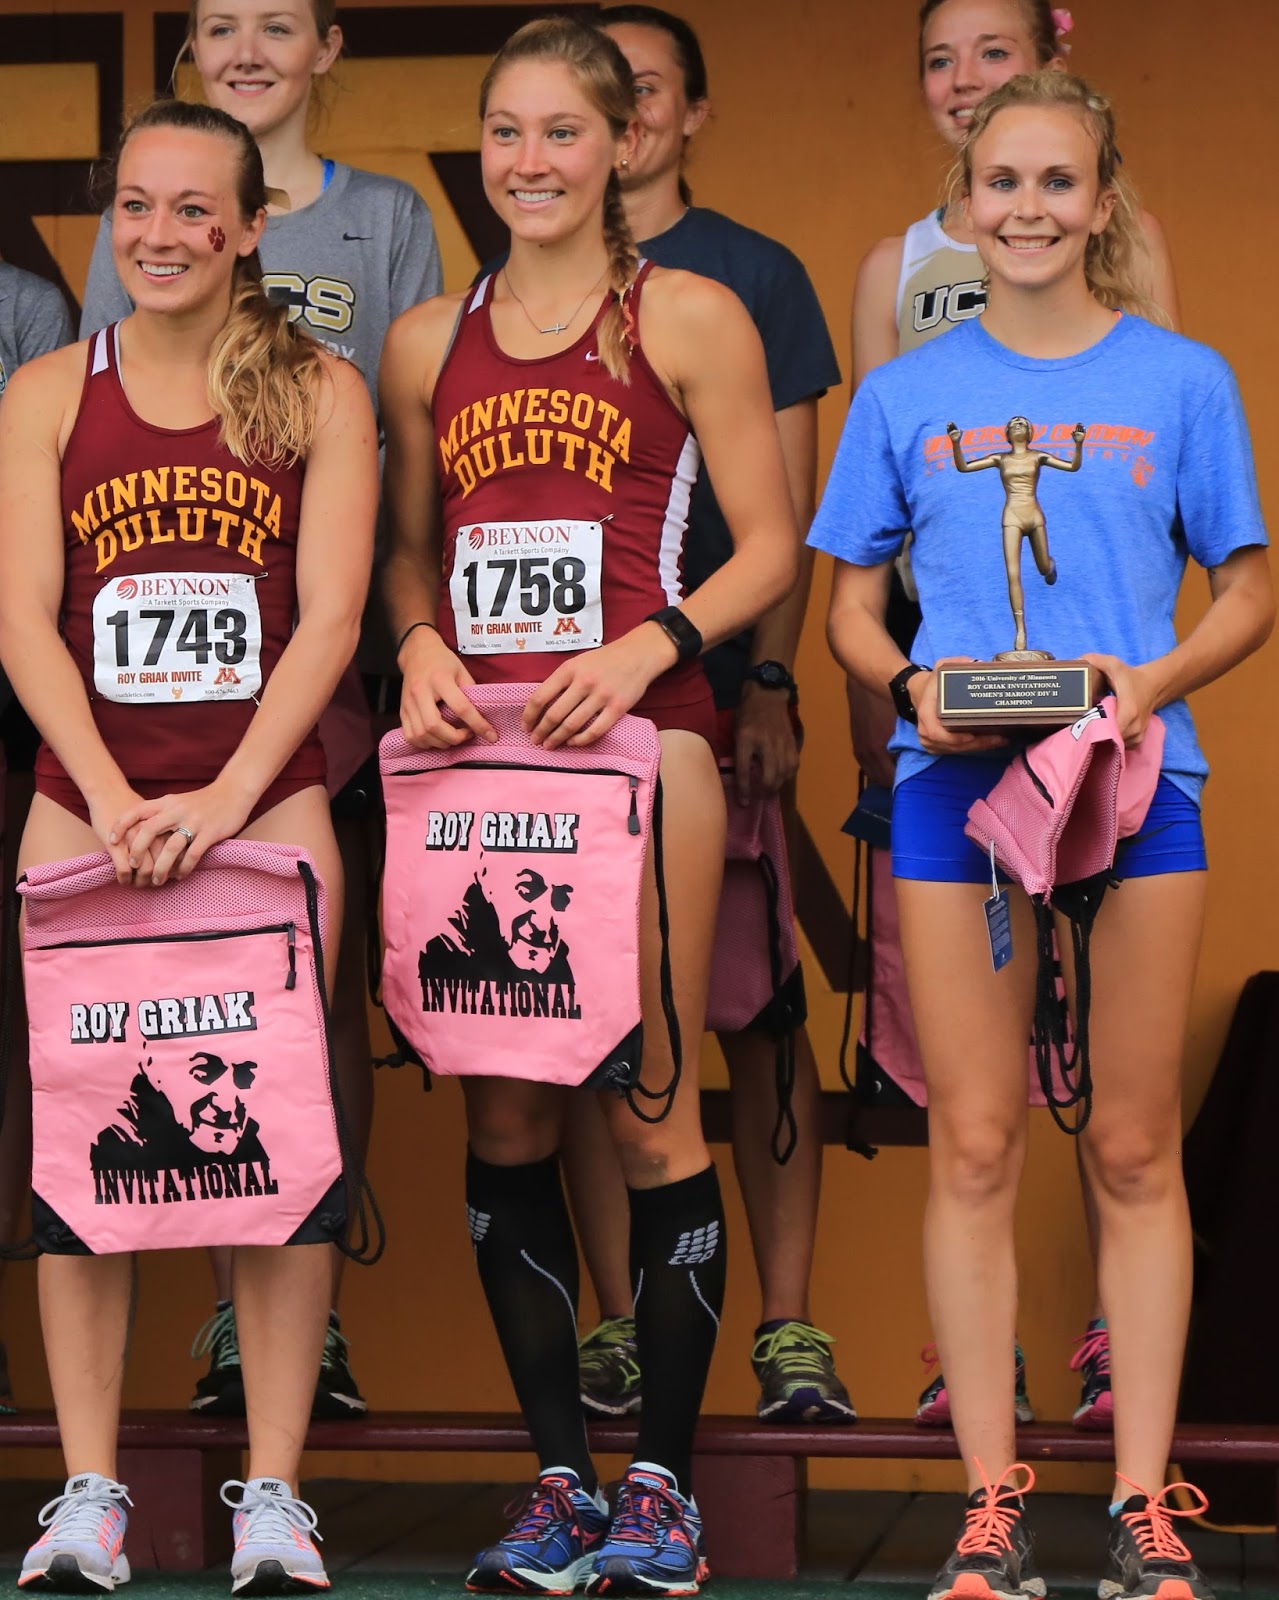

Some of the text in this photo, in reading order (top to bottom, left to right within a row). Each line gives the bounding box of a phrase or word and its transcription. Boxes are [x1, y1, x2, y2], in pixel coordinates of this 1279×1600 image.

[439, 388, 632, 475] MINNESOTA
[1085, 423, 1155, 447] MARY
[453, 429, 616, 500] DULUTH
[71, 466, 282, 546] MINNESOTA
[95, 507, 267, 574] DULUTH
[487, 526, 572, 546] BEYNON
[499, 548, 520, 556] Tarkett
[520, 547, 540, 555] Sports
[540, 546, 570, 555] Company
[141, 578, 230, 597] BEYNON
[463, 557, 587, 618] 1758
[106, 608, 247, 667] 1743
[471, 621, 543, 635] ROY GRIAK INVITE
[117, 670, 203, 684] ROY GRIAK INVITE
[1008, 682, 1061, 690] INVITATIONAL
[426, 811, 580, 854] ROY GRIAK
[71, 991, 257, 1044] ROY GRIAK
[420, 977, 582, 1020] INVITATIONAL
[92, 1161, 279, 1204] INVITATIONAL
[72, 1479, 89, 1490] NIKE
[260, 1482, 281, 1492] NIKE
